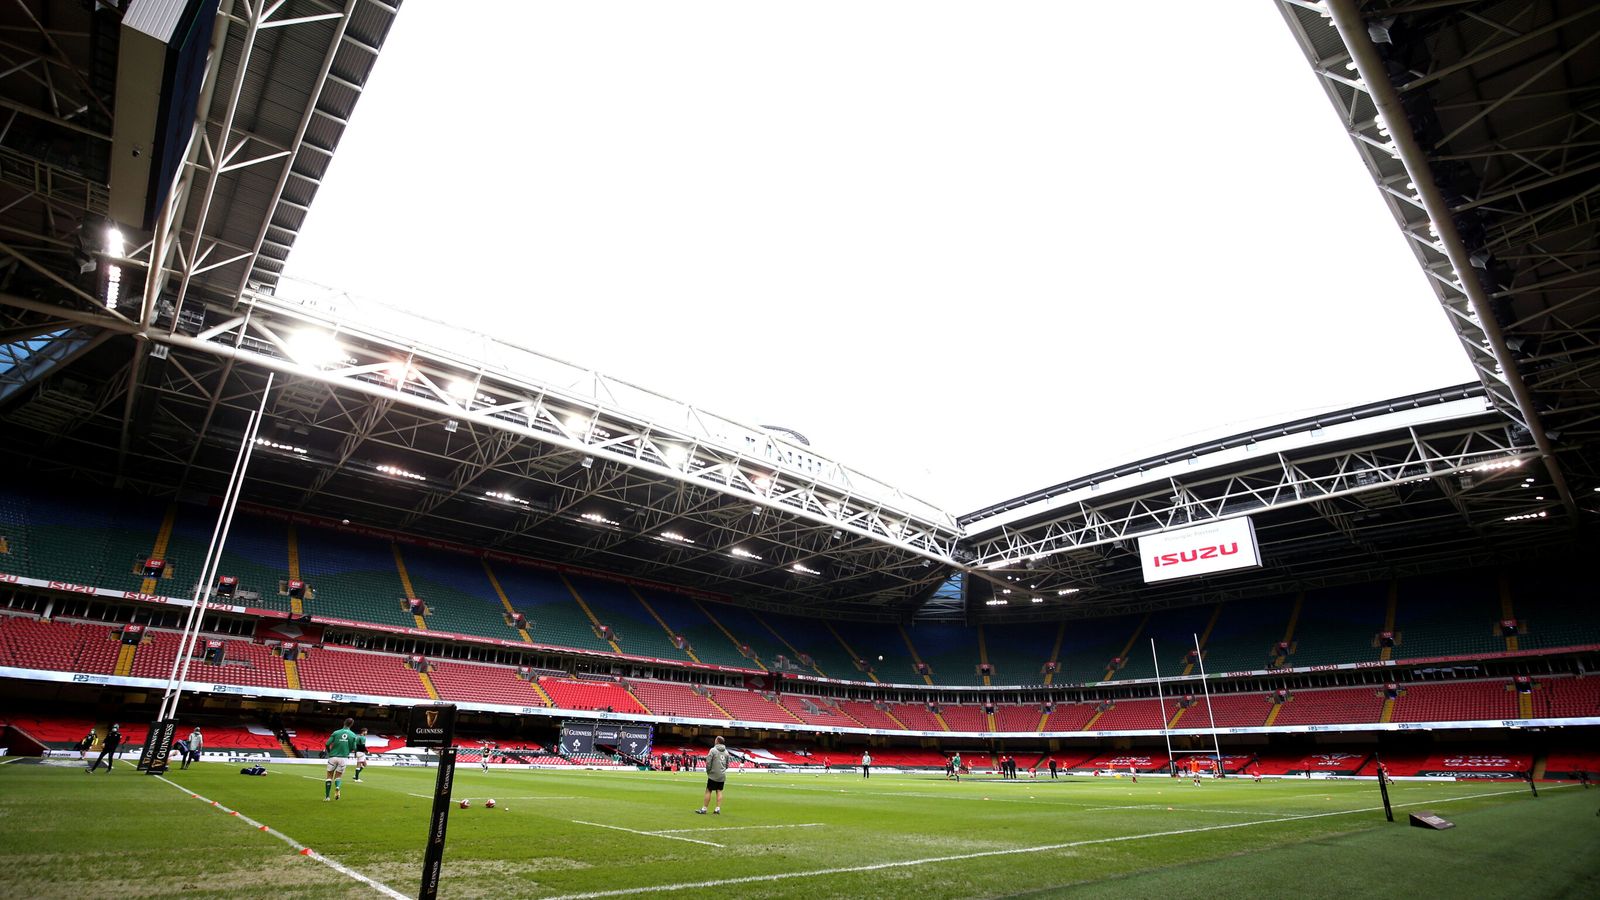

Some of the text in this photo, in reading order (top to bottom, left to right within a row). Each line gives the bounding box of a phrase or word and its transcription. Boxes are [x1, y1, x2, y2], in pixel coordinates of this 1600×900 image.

[1153, 542, 1239, 568] ISUZU
[48, 581, 97, 595] ISUZU
[124, 591, 168, 604] ISUZU
[1310, 663, 1339, 672] ISUZU
[1356, 660, 1386, 669] ISUZU
[415, 727, 444, 735] GUINNESS
[568, 729, 592, 738] GUINNESS
[626, 732, 648, 740] GUINNESS
[157, 723, 175, 759] GUINNESS
[443, 764, 453, 790] GUINNESS
[436, 811, 446, 838] GUINNESS
[429, 860, 439, 889] GUINNESS
